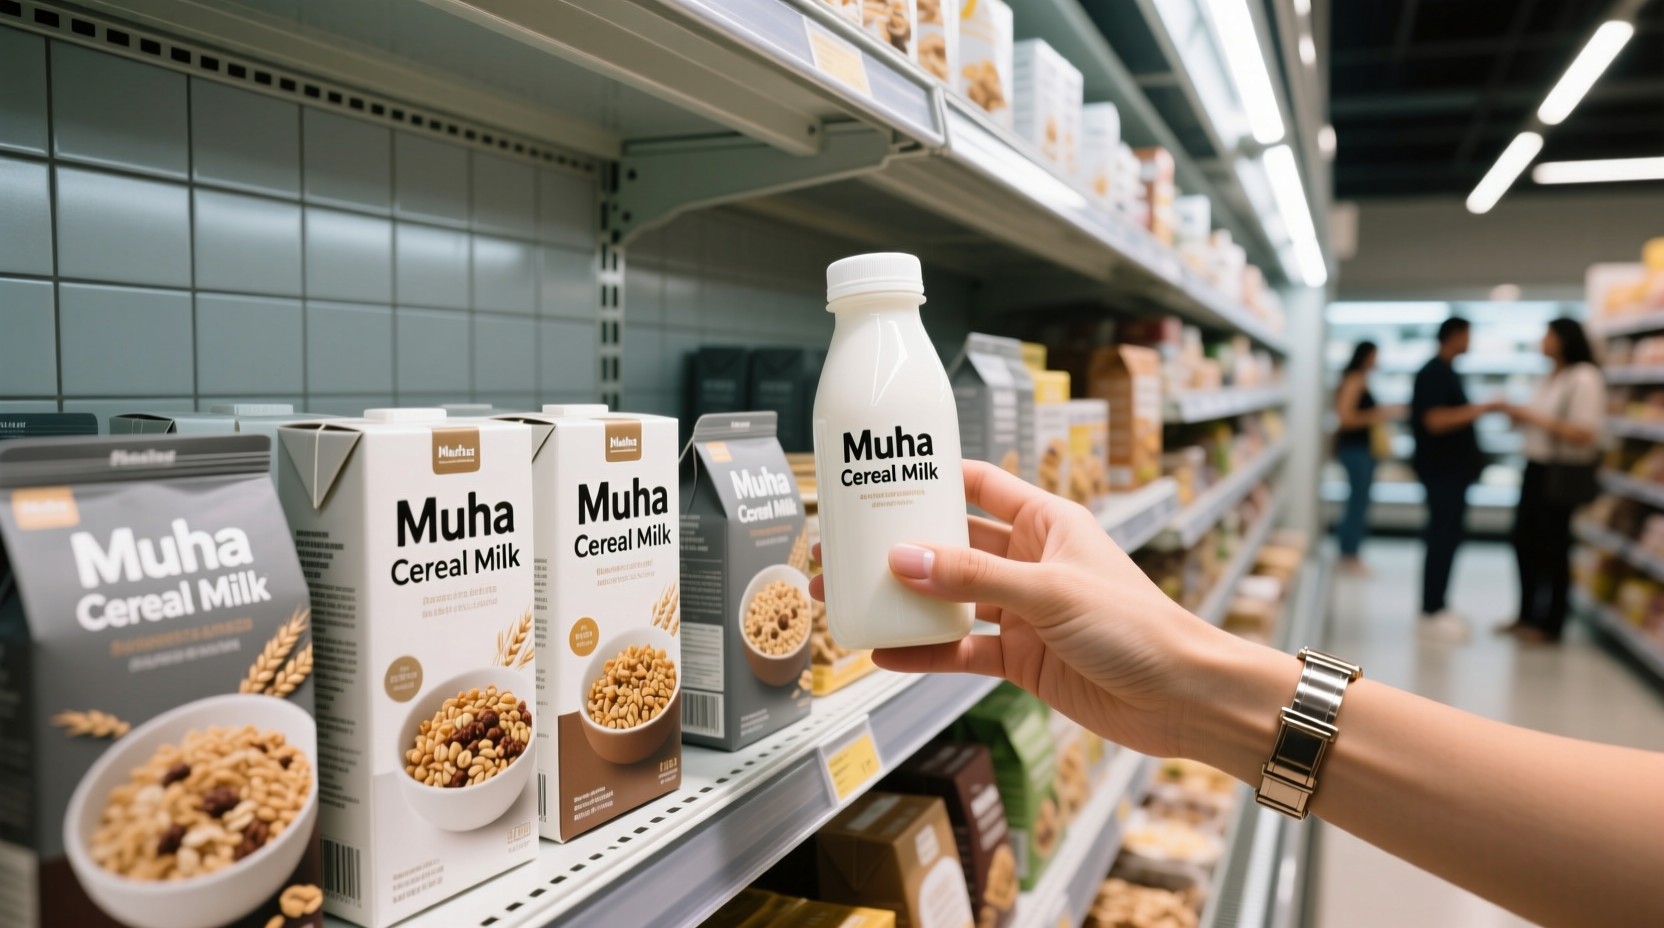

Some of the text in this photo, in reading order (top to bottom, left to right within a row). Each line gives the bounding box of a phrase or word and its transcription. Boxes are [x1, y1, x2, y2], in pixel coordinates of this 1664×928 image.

[842, 425, 934, 463] Muha
[729, 465, 792, 500] Muha
[841, 461, 939, 487] Cereal Milk
[396, 491, 515, 548] Muha
[578, 477, 669, 525] Muha
[70, 517, 255, 590] Muha
[574, 533, 633, 558] Cereal
[637, 522, 672, 549] Milk
[391, 542, 521, 586] Cereal Milk
[76, 569, 272, 632] Cereal Milk
